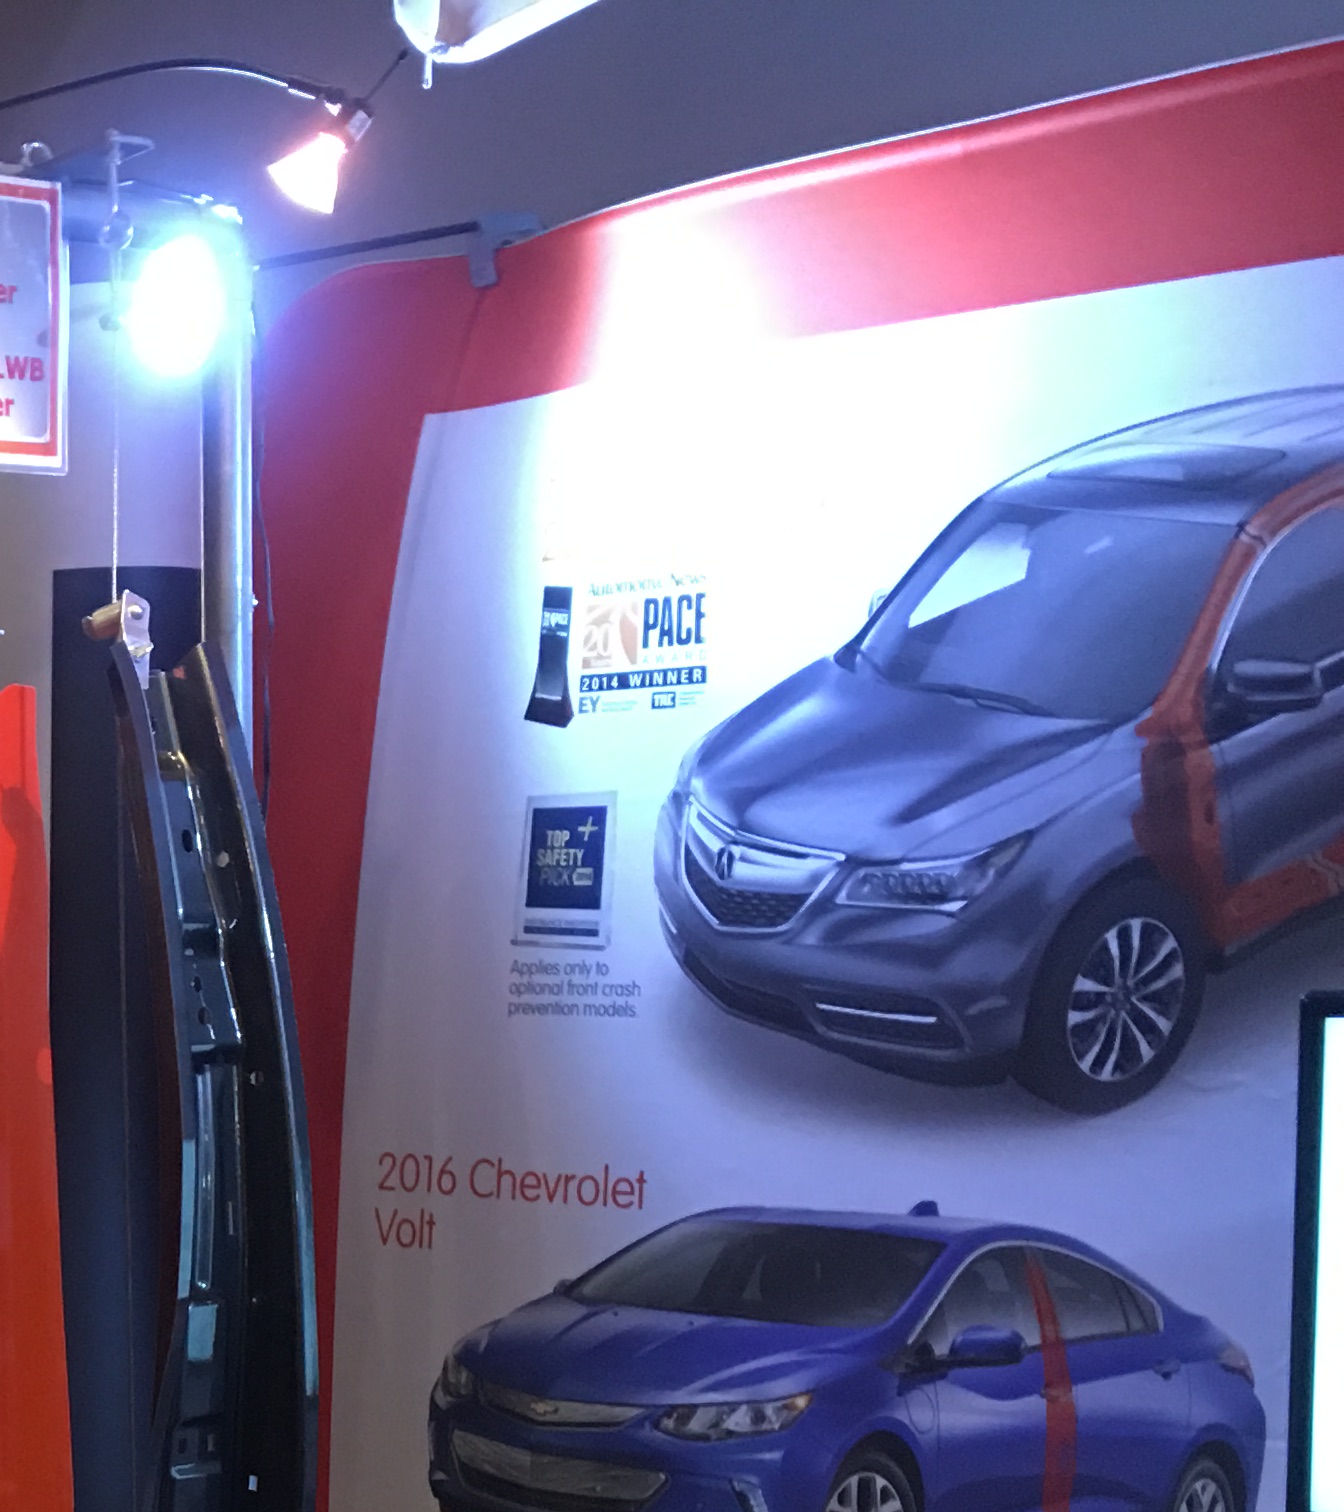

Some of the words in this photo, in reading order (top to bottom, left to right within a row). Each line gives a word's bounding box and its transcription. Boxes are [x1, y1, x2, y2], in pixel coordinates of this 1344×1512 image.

[642, 592, 706, 649] PACE
[582, 676, 618, 690] 2014
[629, 668, 702, 686] WINNER
[546, 830, 570, 846] TOP
[536, 848, 584, 866] SAFETY
[510, 959, 560, 978] Applies
[564, 960, 593, 978] only
[596, 961, 610, 976] to
[509, 980, 564, 998] optional
[567, 980, 598, 996] front
[602, 980, 641, 996] crash
[508, 1001, 579, 1018] prevention
[377, 1152, 457, 1196] 2016
[469, 1157, 647, 1209] Chevrolet
[374, 1207, 436, 1249] Volt
